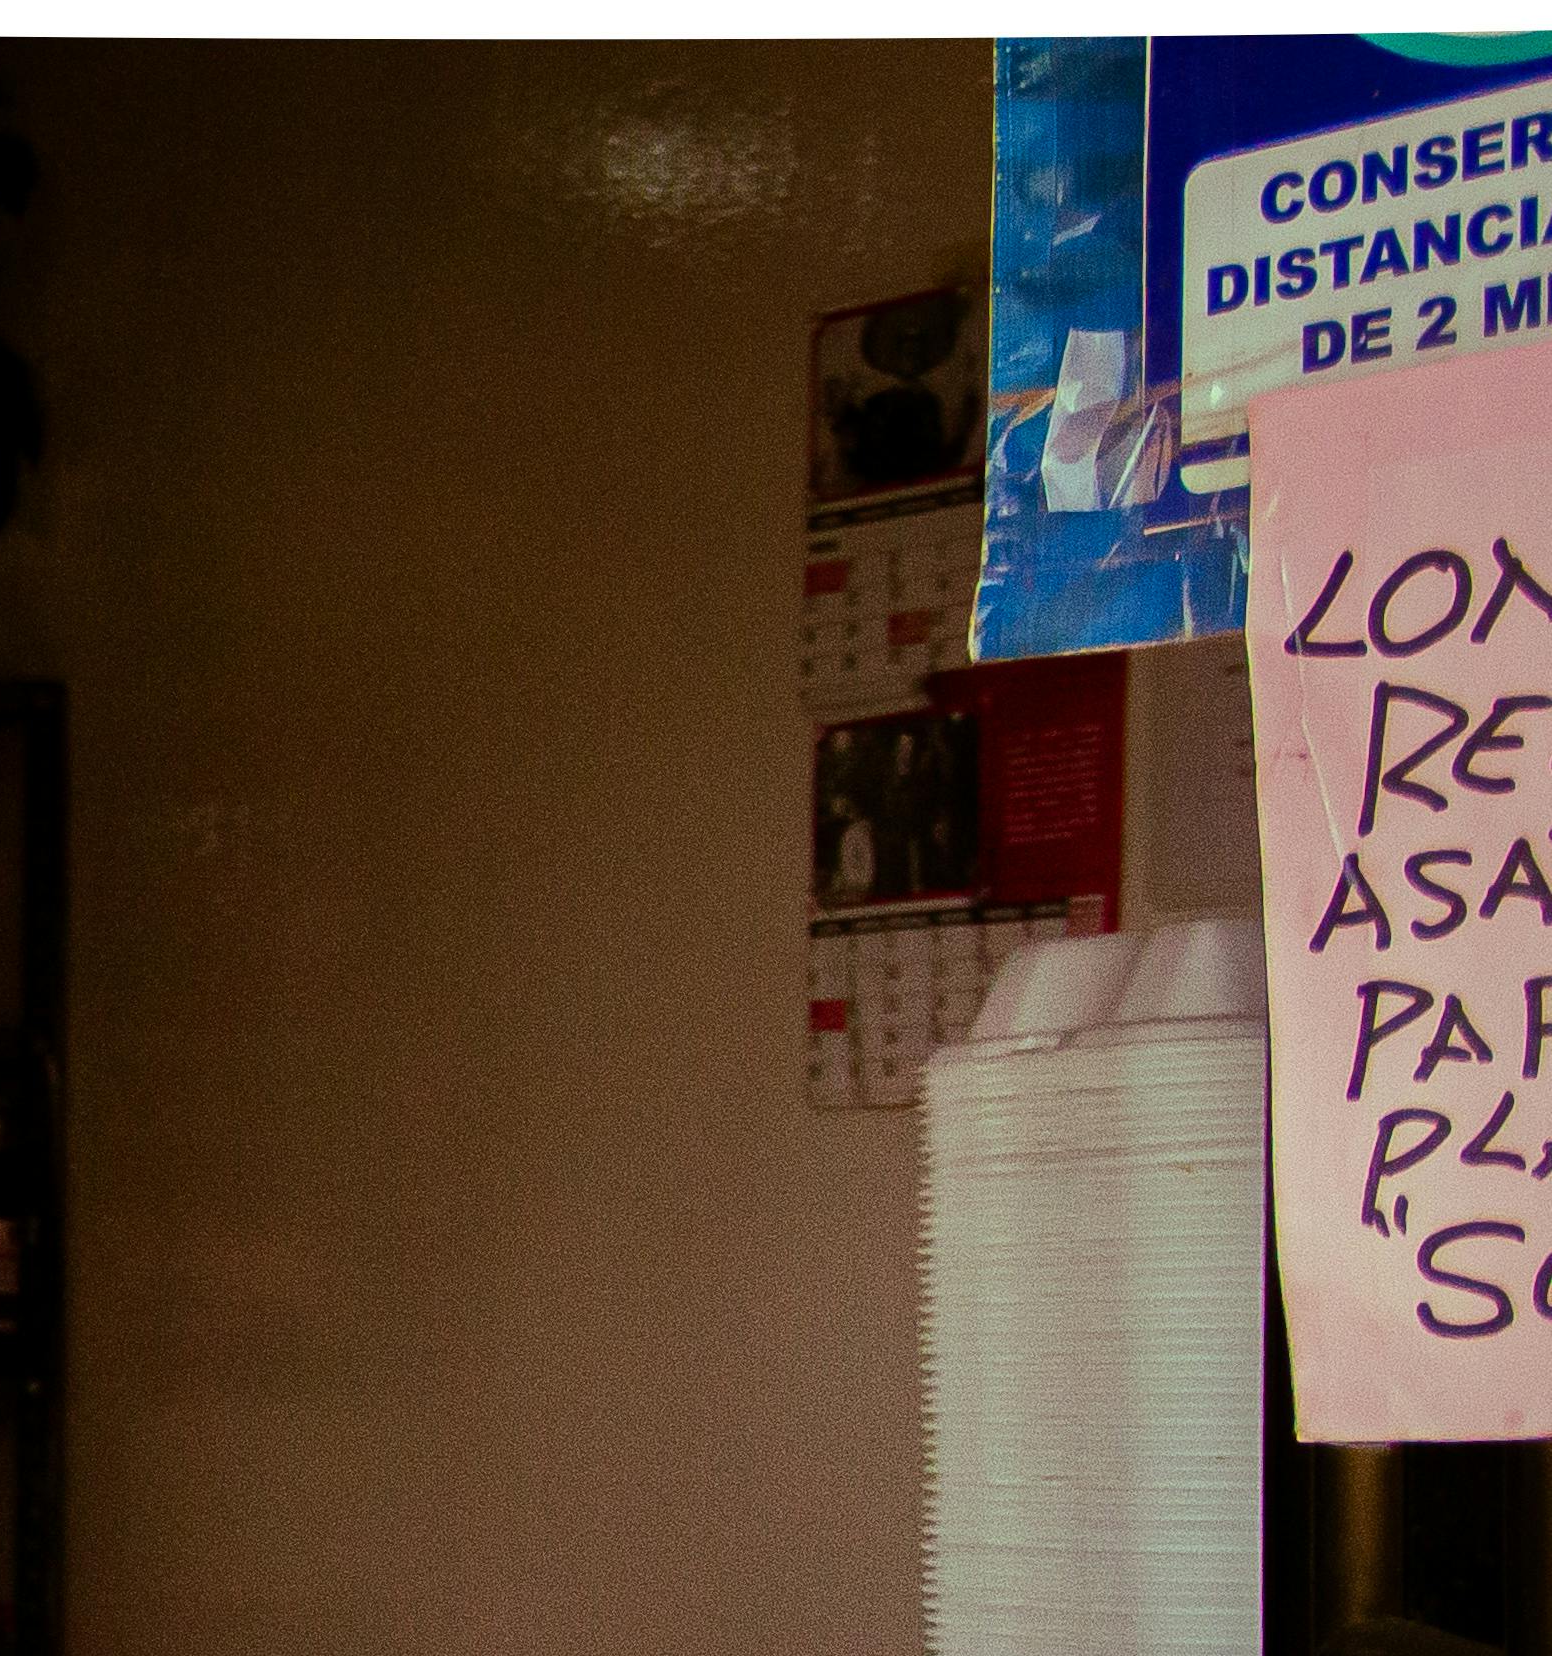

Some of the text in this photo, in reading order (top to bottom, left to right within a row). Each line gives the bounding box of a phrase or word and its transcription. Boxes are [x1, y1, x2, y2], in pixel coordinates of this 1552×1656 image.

[1260, 110, 1552, 225] CONSER
[1206, 194, 1552, 317] DISTANCI
[1302, 272, 1552, 374] DE 2 M
[1358, 681, 1552, 837] RE
[1309, 829, 1552, 951] ASA
[1362, 1090, 1552, 1227] PL
